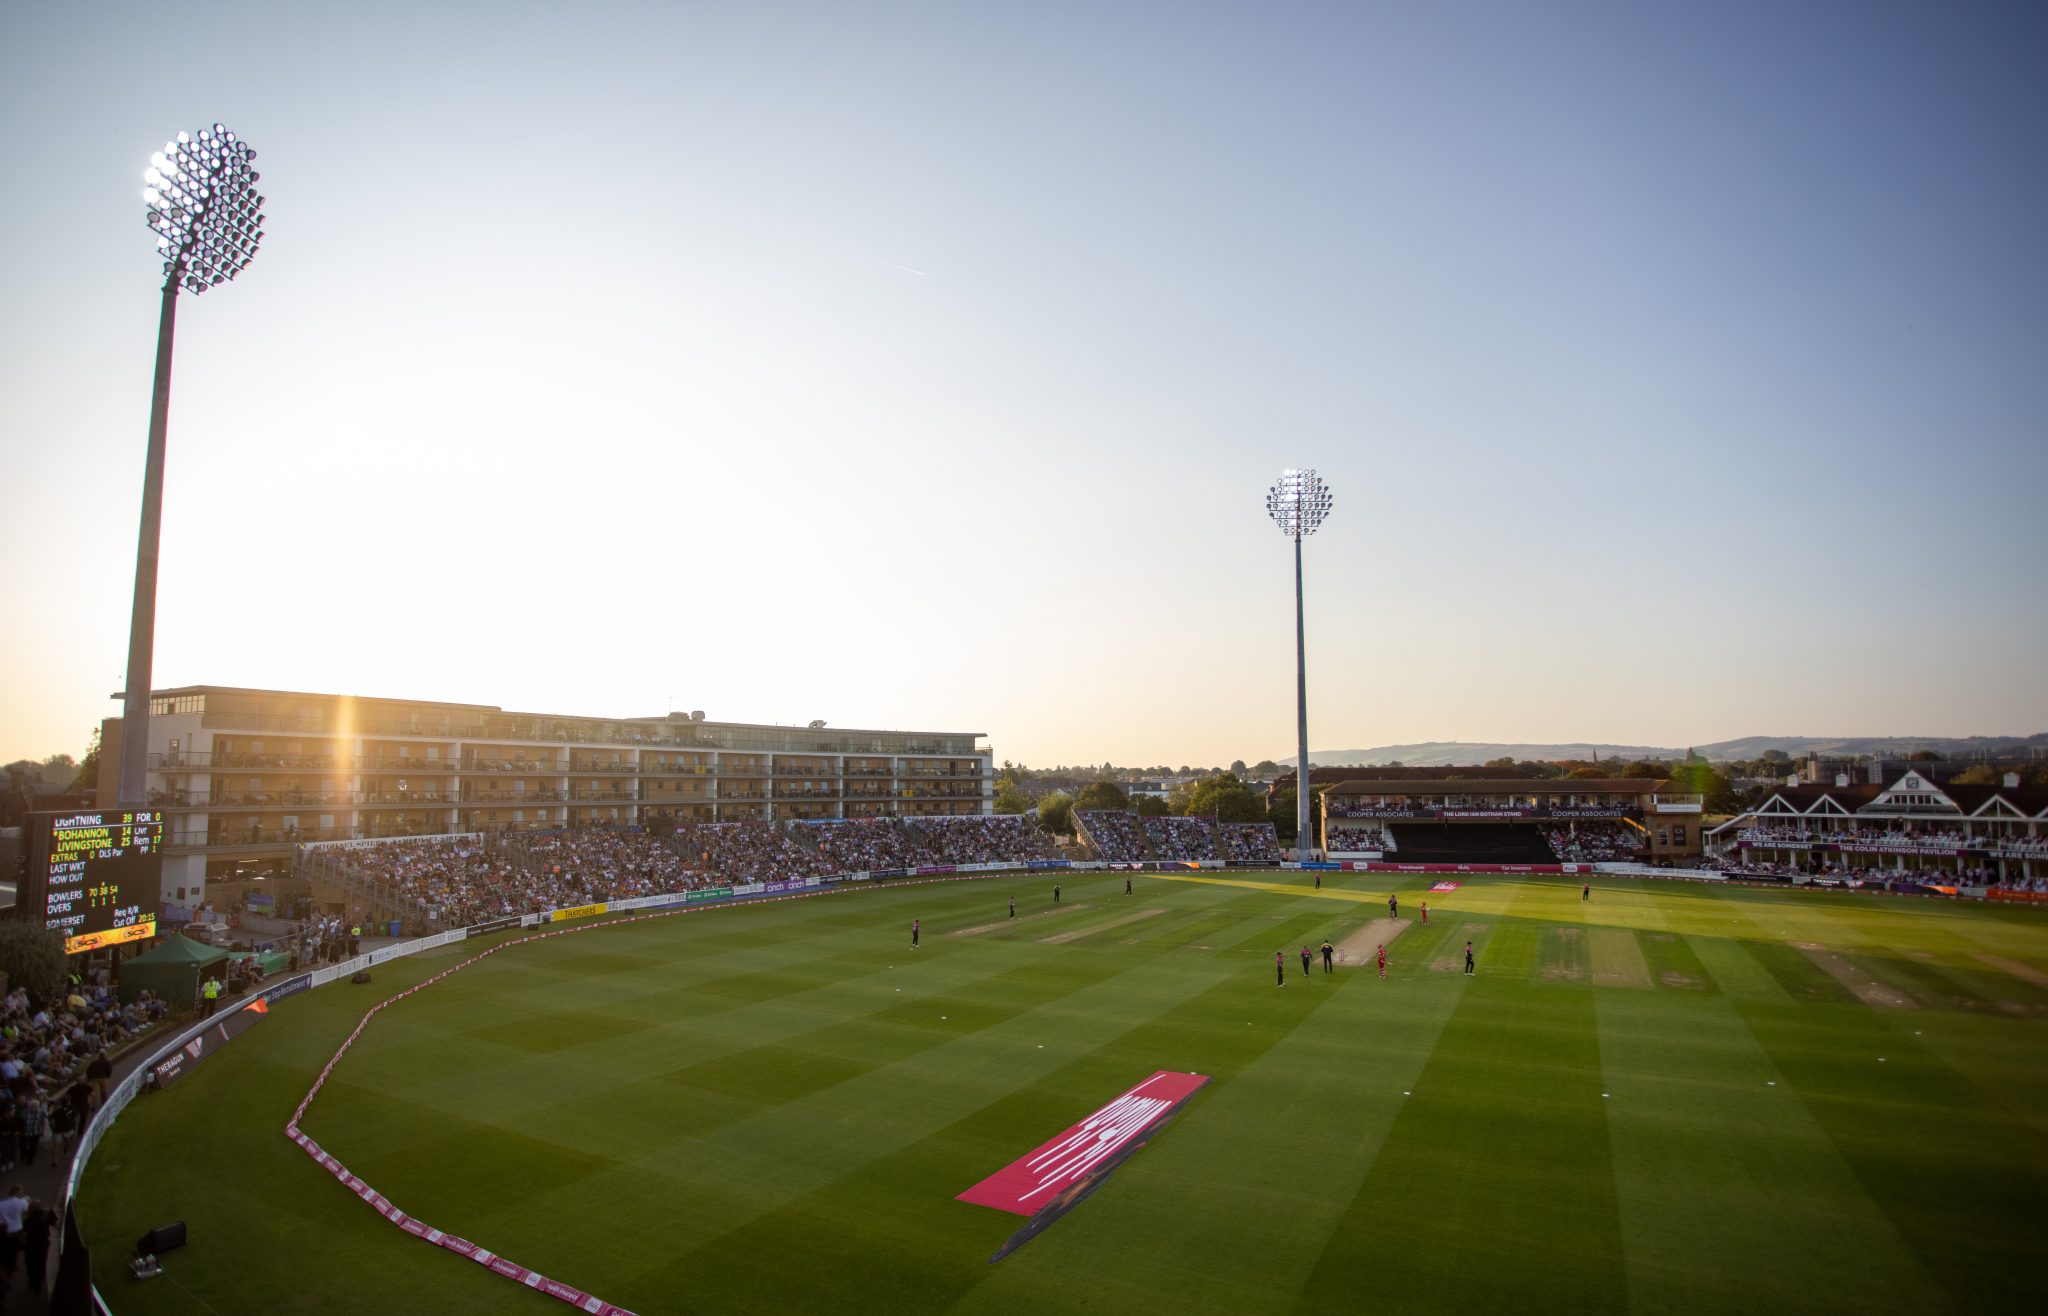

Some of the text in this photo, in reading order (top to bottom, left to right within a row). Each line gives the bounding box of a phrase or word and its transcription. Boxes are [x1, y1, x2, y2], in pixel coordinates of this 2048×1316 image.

[122, 814, 132, 823] 39
[136, 813, 152, 822] FOR
[156, 812, 160, 821] 0
[122, 826, 132, 836] 14
[158, 825, 163, 834] 3
[57, 836, 162, 852] LIVINGSTONE 25 Rem 17
[50, 852, 78, 863] EXTRAS
[90, 850, 95, 860] 0
[98, 849, 112, 858] DLS
[112, 848, 124, 856] Par
[50, 862, 86, 874] LAST WKT
[48, 872, 84, 885] HOW OUT
[767, 883, 784, 892] cinch
[788, 880, 804, 890] cinch
[48, 890, 83, 903] BOWLERS
[110, 886, 118, 894] 54
[46, 902, 72, 914] OVERS
[114, 905, 140, 918] Req R/R
[564, 906, 596, 918] THATCHERS
[114, 918, 125, 928] Cut
[126, 916, 136, 925] Off
[156, 1052, 184, 1074] THERAGUN
